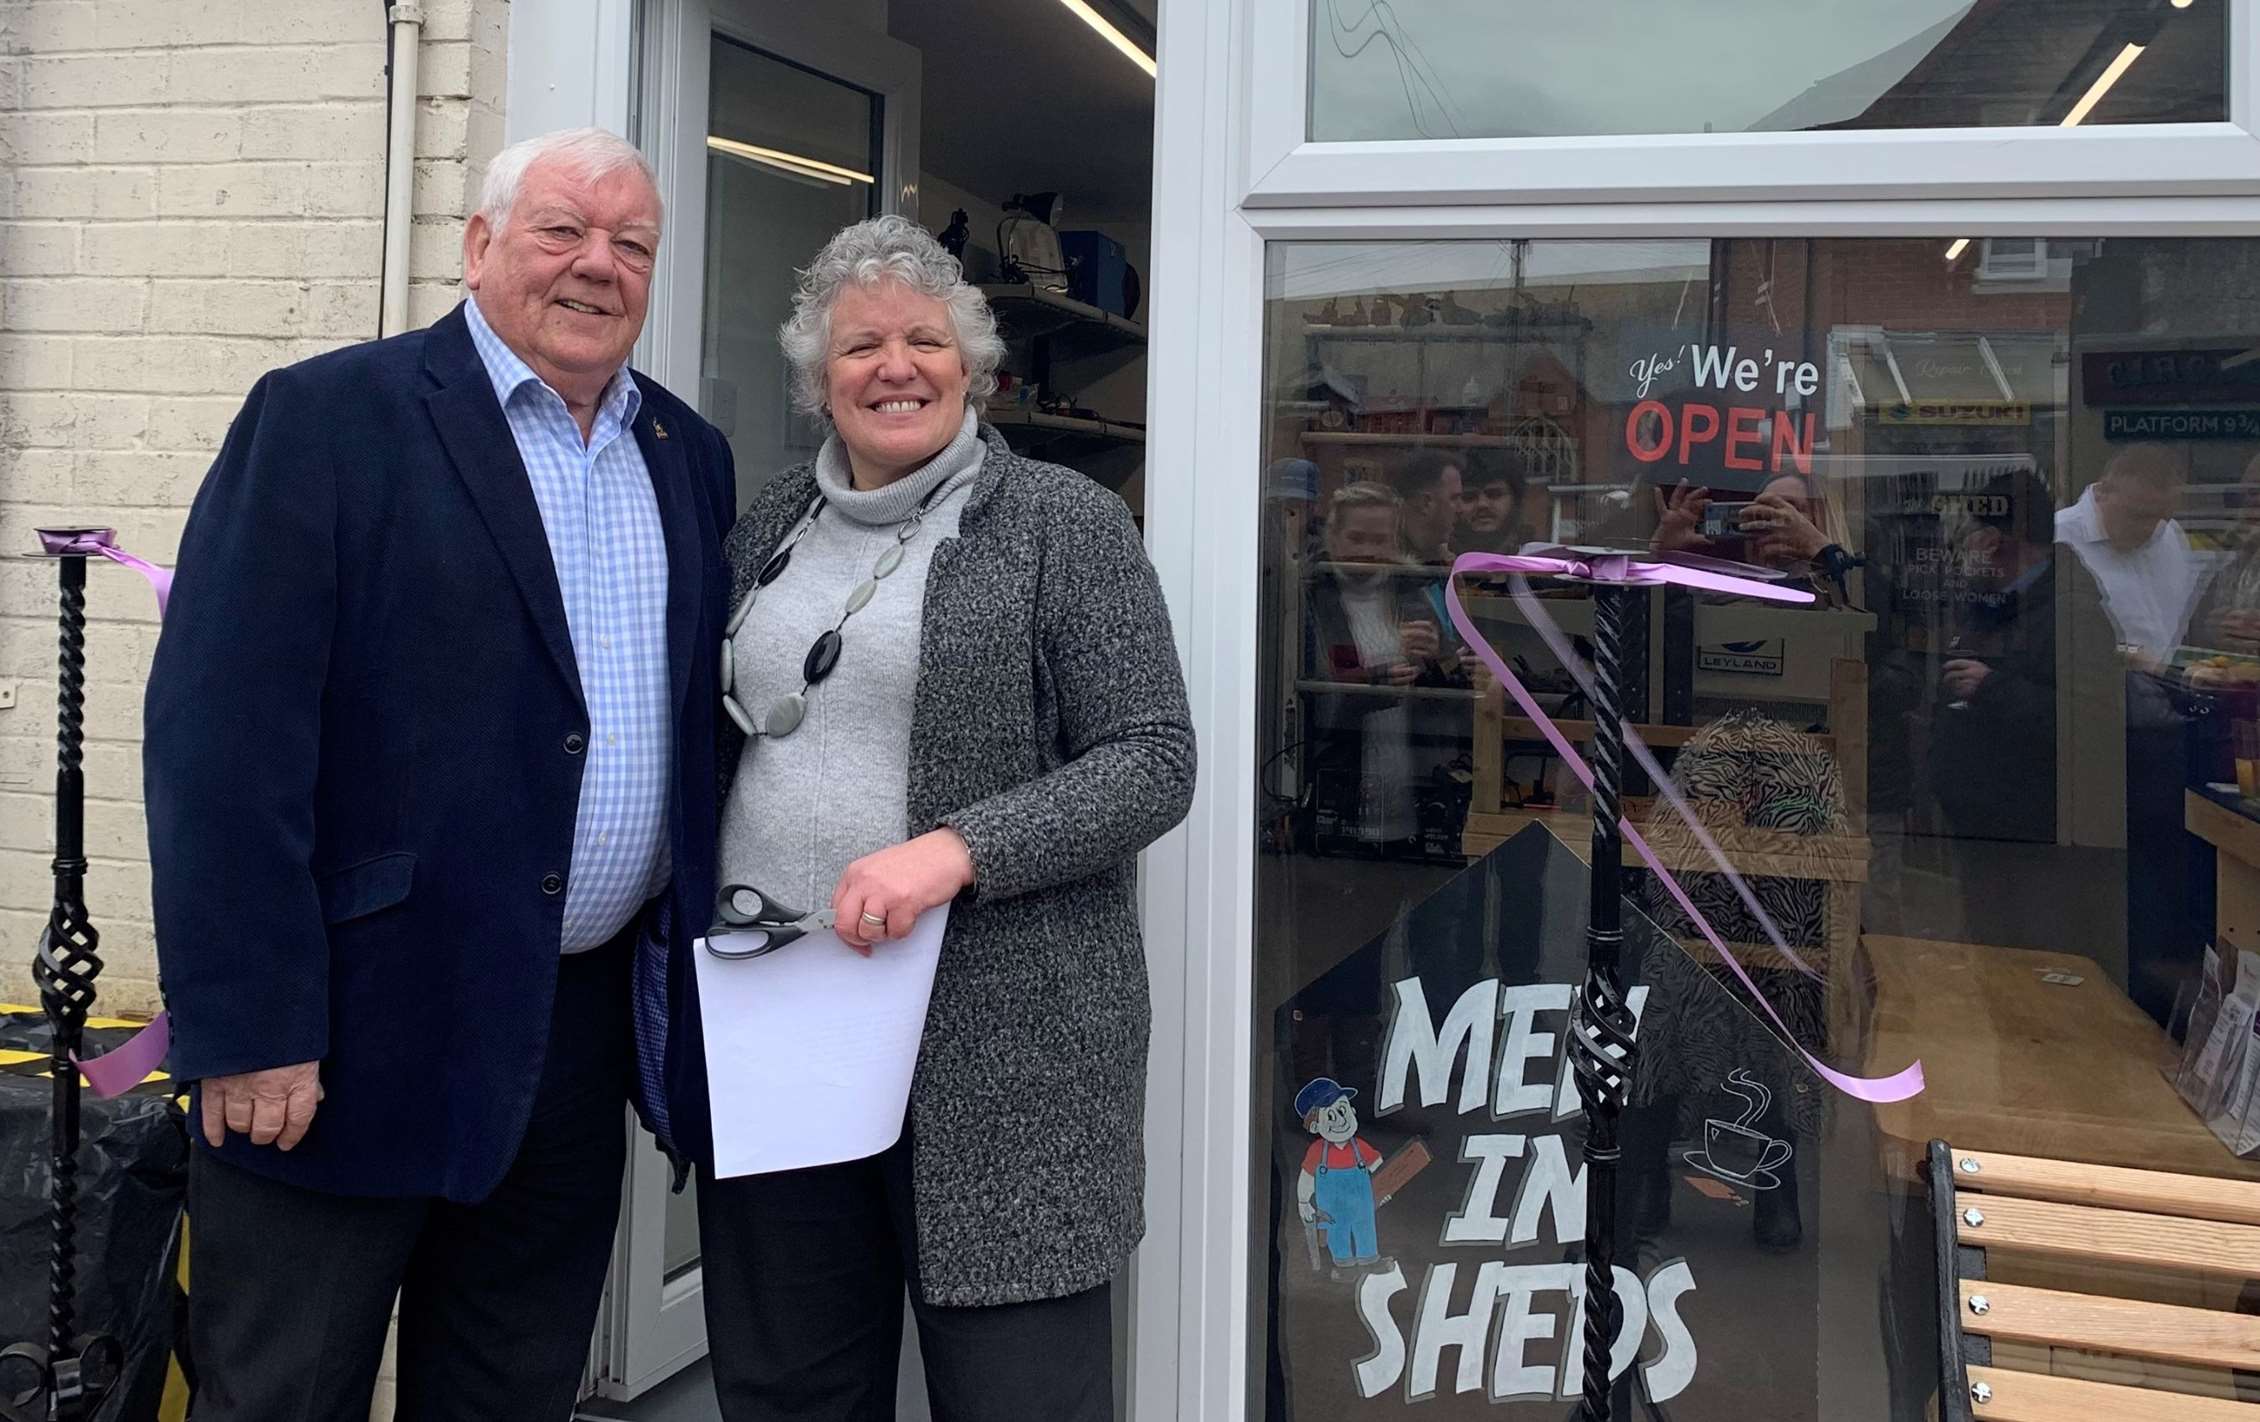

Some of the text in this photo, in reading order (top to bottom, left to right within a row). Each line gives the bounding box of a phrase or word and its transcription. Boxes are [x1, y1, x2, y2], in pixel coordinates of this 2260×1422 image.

[1629, 344, 1819, 399] Yes! We're
[1919, 404, 2024, 420] SUZUKI
[2111, 416, 2219, 433] PLATFORM
[1625, 400, 1816, 475] OPEN
[1931, 495, 2009, 516] SHED
[1916, 548, 1992, 564] BEWARE
[1908, 564, 1936, 575] PICK
[1943, 578, 1969, 589] AND
[1903, 589, 2006, 604] LOOSE WOMEN
[1704, 656, 1777, 671] LEYLAND
[1351, 1256, 1699, 1405] SHEDS
